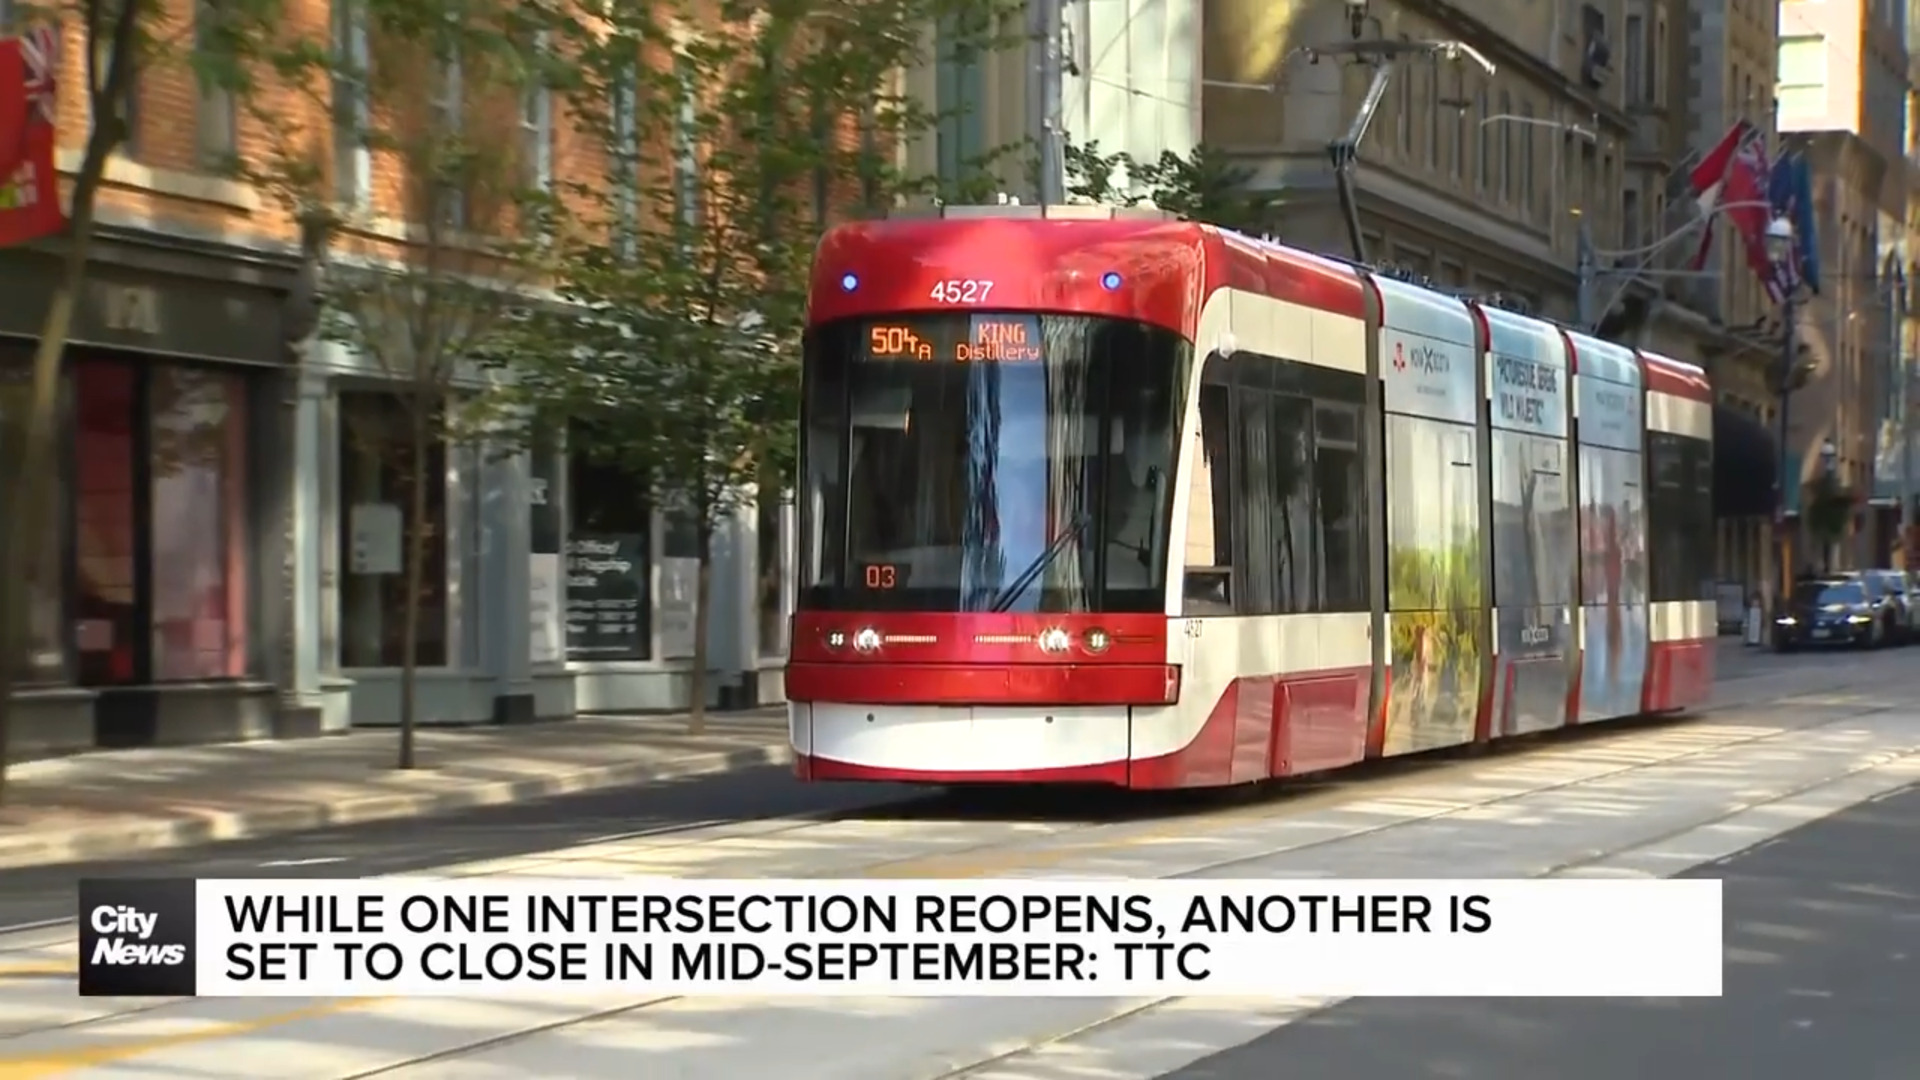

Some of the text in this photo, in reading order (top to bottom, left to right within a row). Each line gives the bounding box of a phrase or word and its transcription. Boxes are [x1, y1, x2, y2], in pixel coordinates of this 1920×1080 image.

[930, 279, 994, 303] 4527
[977, 322, 1026, 345] KING
[956, 343, 1041, 361] Distillery
[865, 564, 896, 589] 03
